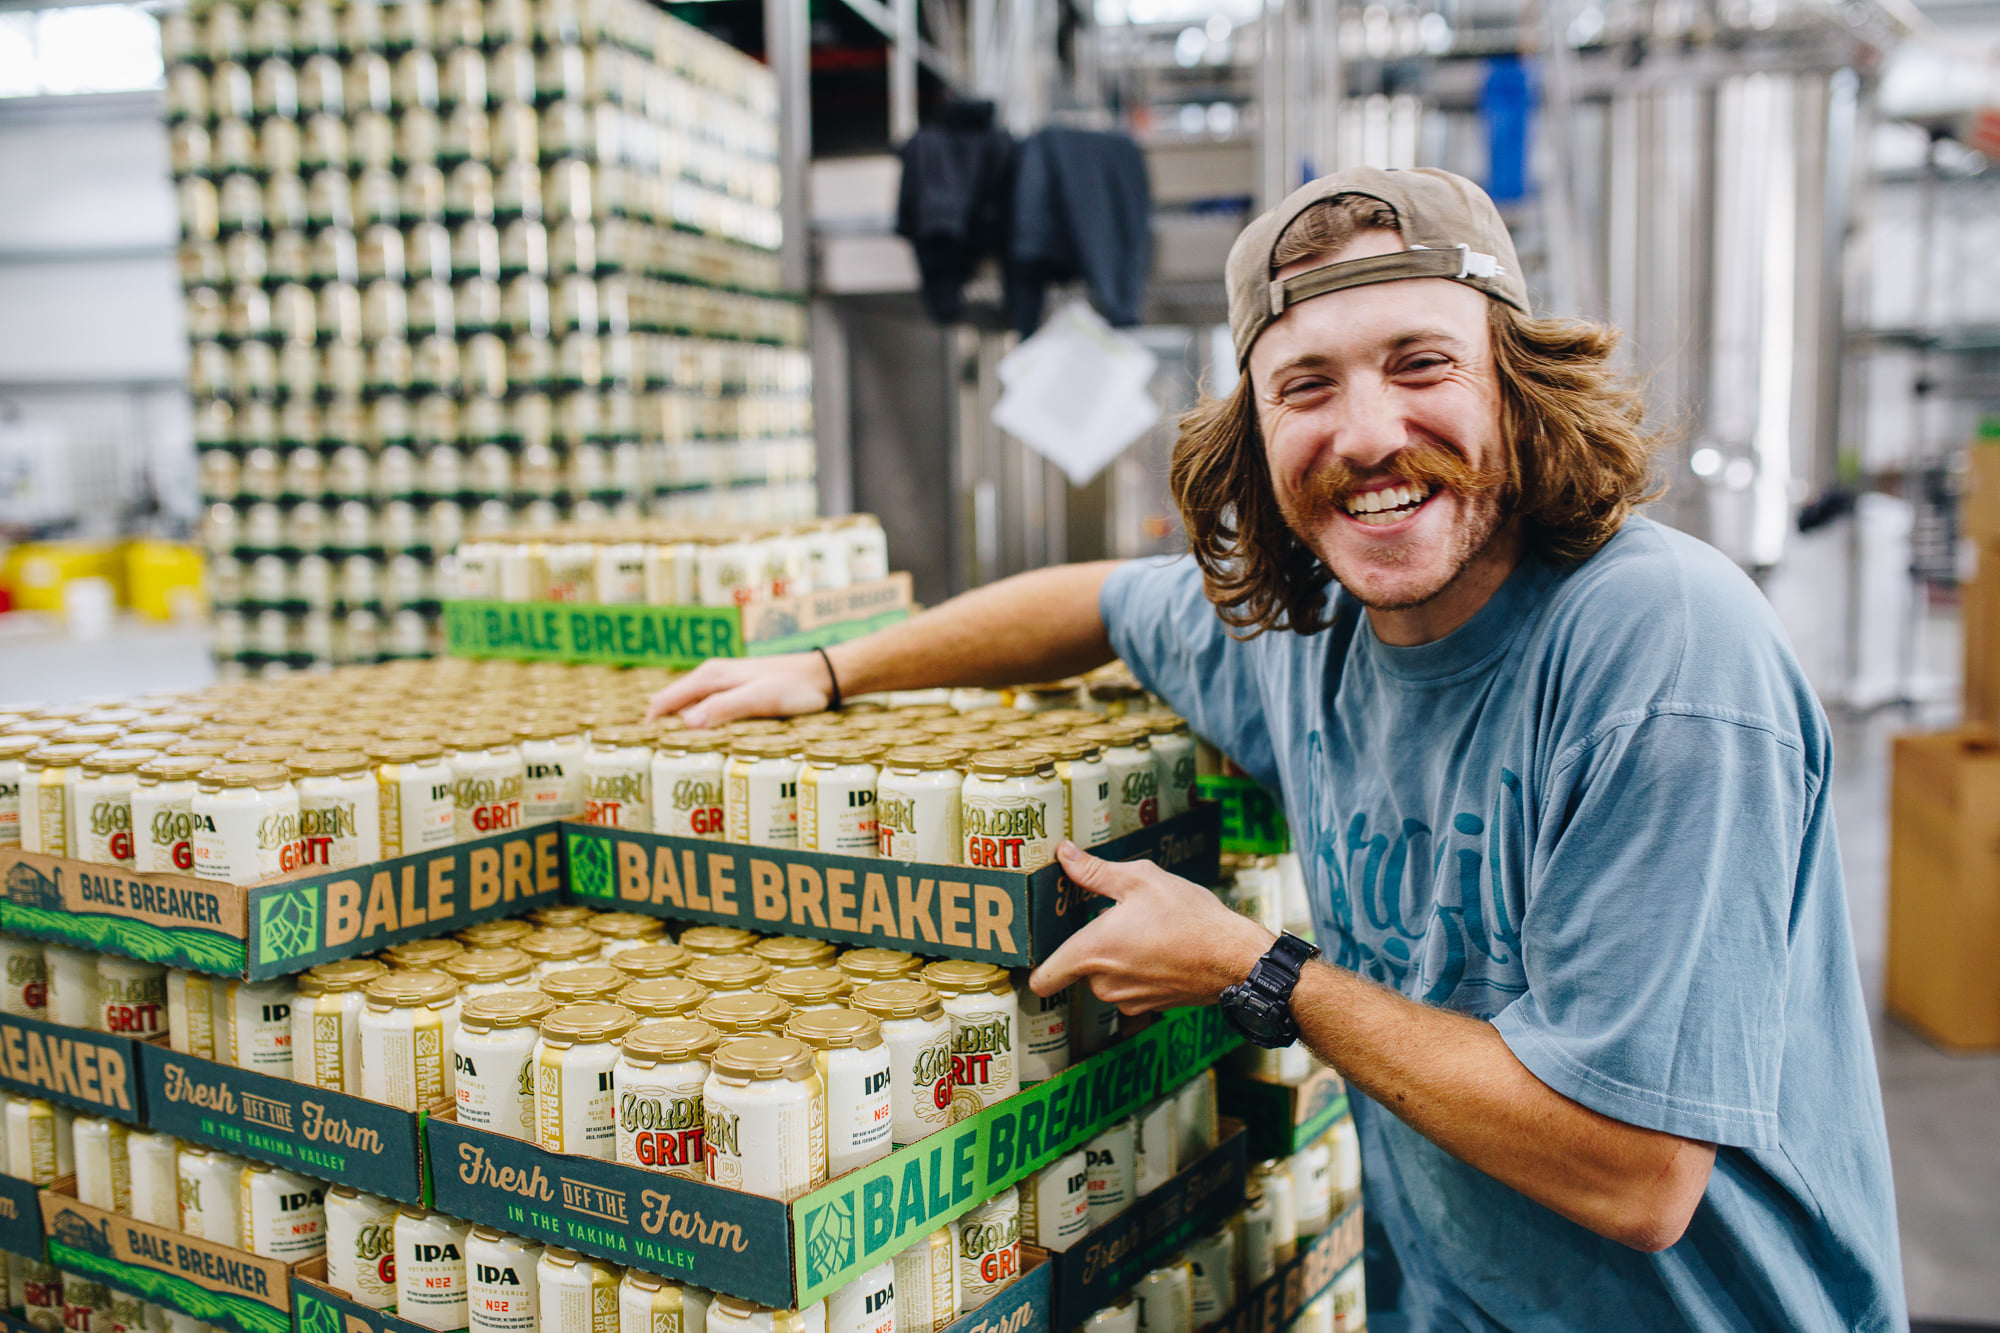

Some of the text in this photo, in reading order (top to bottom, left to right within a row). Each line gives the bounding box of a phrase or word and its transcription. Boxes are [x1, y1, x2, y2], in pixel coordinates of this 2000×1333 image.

[484, 609, 736, 658] BALE BREAKER
[527, 763, 563, 779] IPA
[193, 814, 217, 833] PA
[473, 801, 519, 832] GRIT
[969, 836, 1025, 868] GRIT
[80, 873, 222, 926] BALE BREAKER
[325, 856, 456, 948] BALE
[617, 840, 1018, 955] BALE BREAKER
[262, 1003, 291, 1022] IP
[0, 1024, 132, 1111] EAKER
[455, 1052, 477, 1077] PA
[865, 1065, 891, 1096] IPA
[164, 1063, 384, 1155] Fresh OFF THE Farm
[547, 1095, 560, 1137] BALE
[201, 1117, 346, 1172] IN THE YAKIMA VALLEY
[636, 1129, 705, 1167] GRIT
[863, 1129, 977, 1257] BALE
[986, 1036, 1158, 1187] BREAKER
[1086, 1149, 1114, 1168] PA
[280, 1188, 324, 1212] IPA
[458, 1142, 748, 1253] Fresh OFF THE Farm
[415, 1242, 462, 1263] IPA
[508, 1204, 696, 1271] IN THE YAKIMA VALLEY
[127, 1229, 270, 1298] BALE BREAKER
[476, 1263, 520, 1286] IPA
[865, 1281, 894, 1315] IPA
